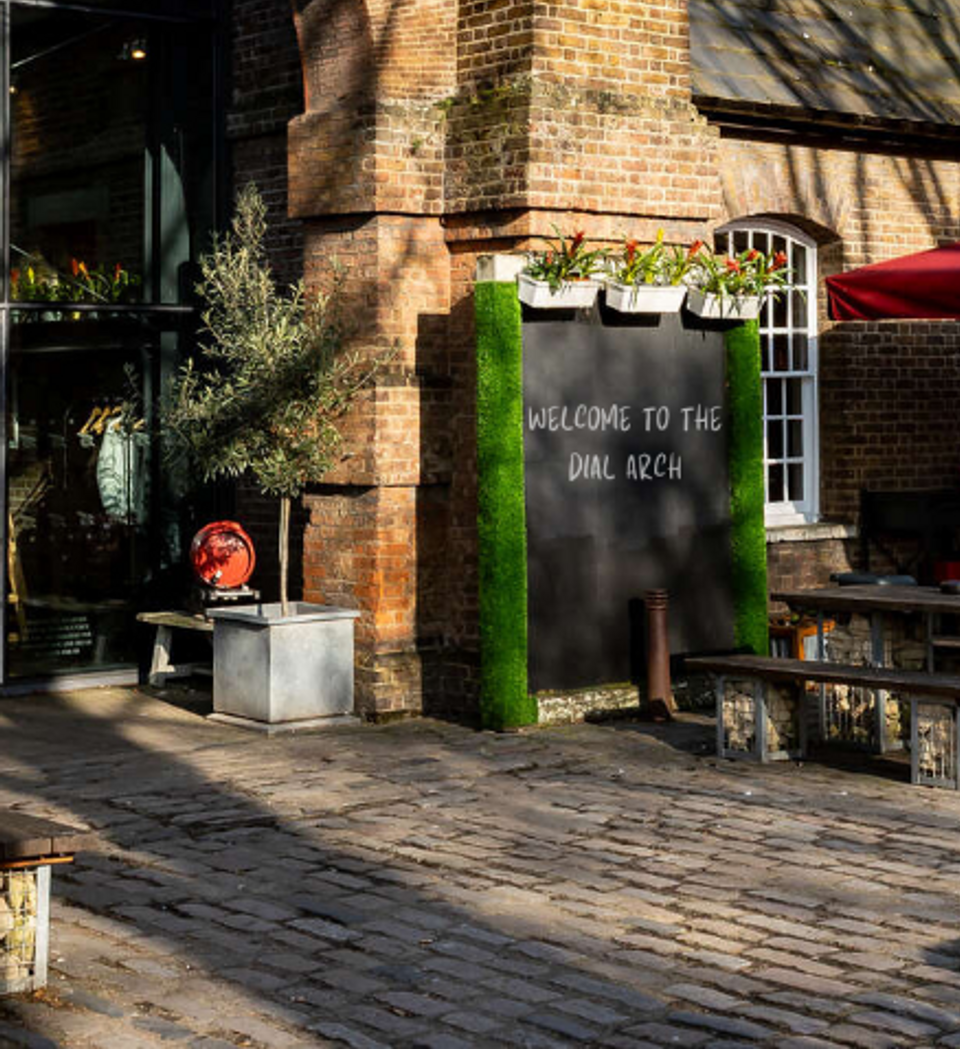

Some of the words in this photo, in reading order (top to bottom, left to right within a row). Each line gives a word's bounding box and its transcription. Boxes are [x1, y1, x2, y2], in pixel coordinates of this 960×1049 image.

[527, 403, 631, 432] WELCOME
[642, 405, 670, 432] TO
[680, 403, 723, 432] THE
[568, 452, 616, 482] DIAL
[625, 452, 682, 480] ARCH
